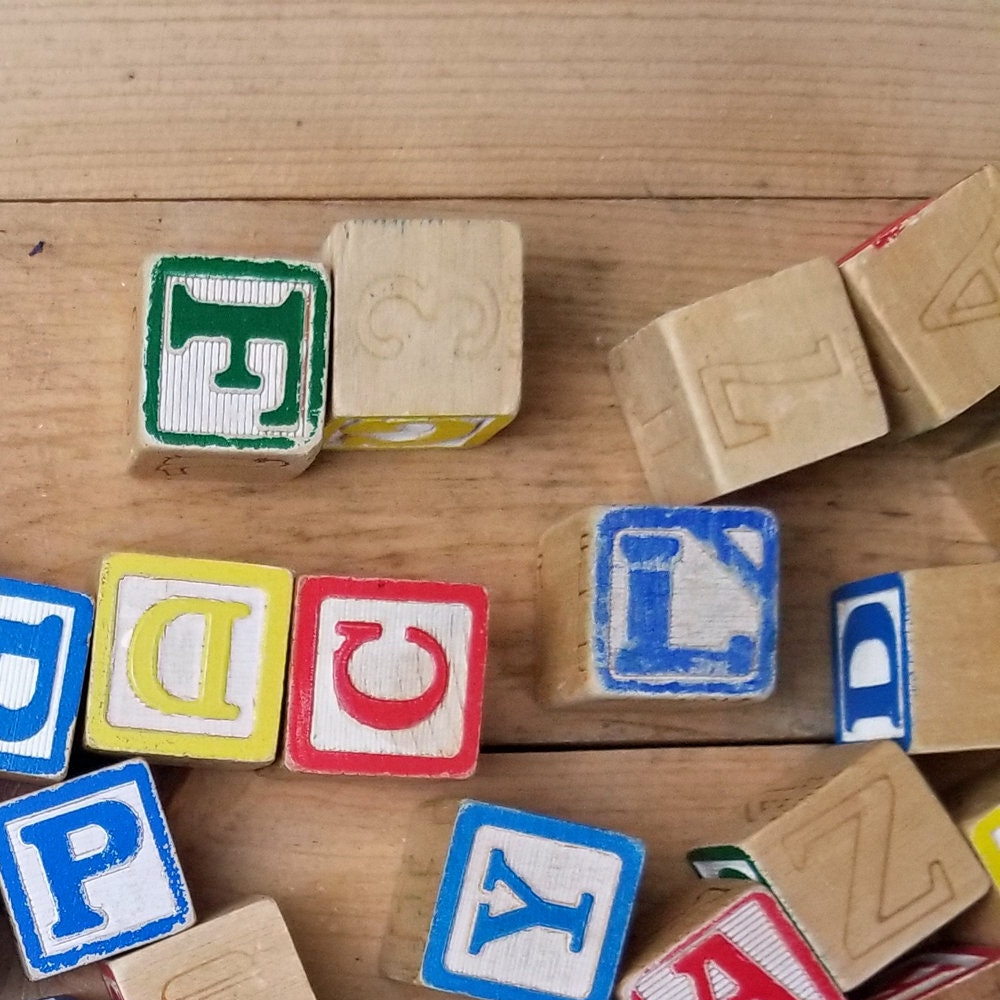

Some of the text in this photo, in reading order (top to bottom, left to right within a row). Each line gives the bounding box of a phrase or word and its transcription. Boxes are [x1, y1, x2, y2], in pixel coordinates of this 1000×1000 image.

[169, 282, 306, 428] F
[127, 596, 251, 721] D
[613, 534, 755, 676] L
[334, 621, 449, 730] C
[20, 799, 145, 940] P
[470, 848, 595, 956] Y
